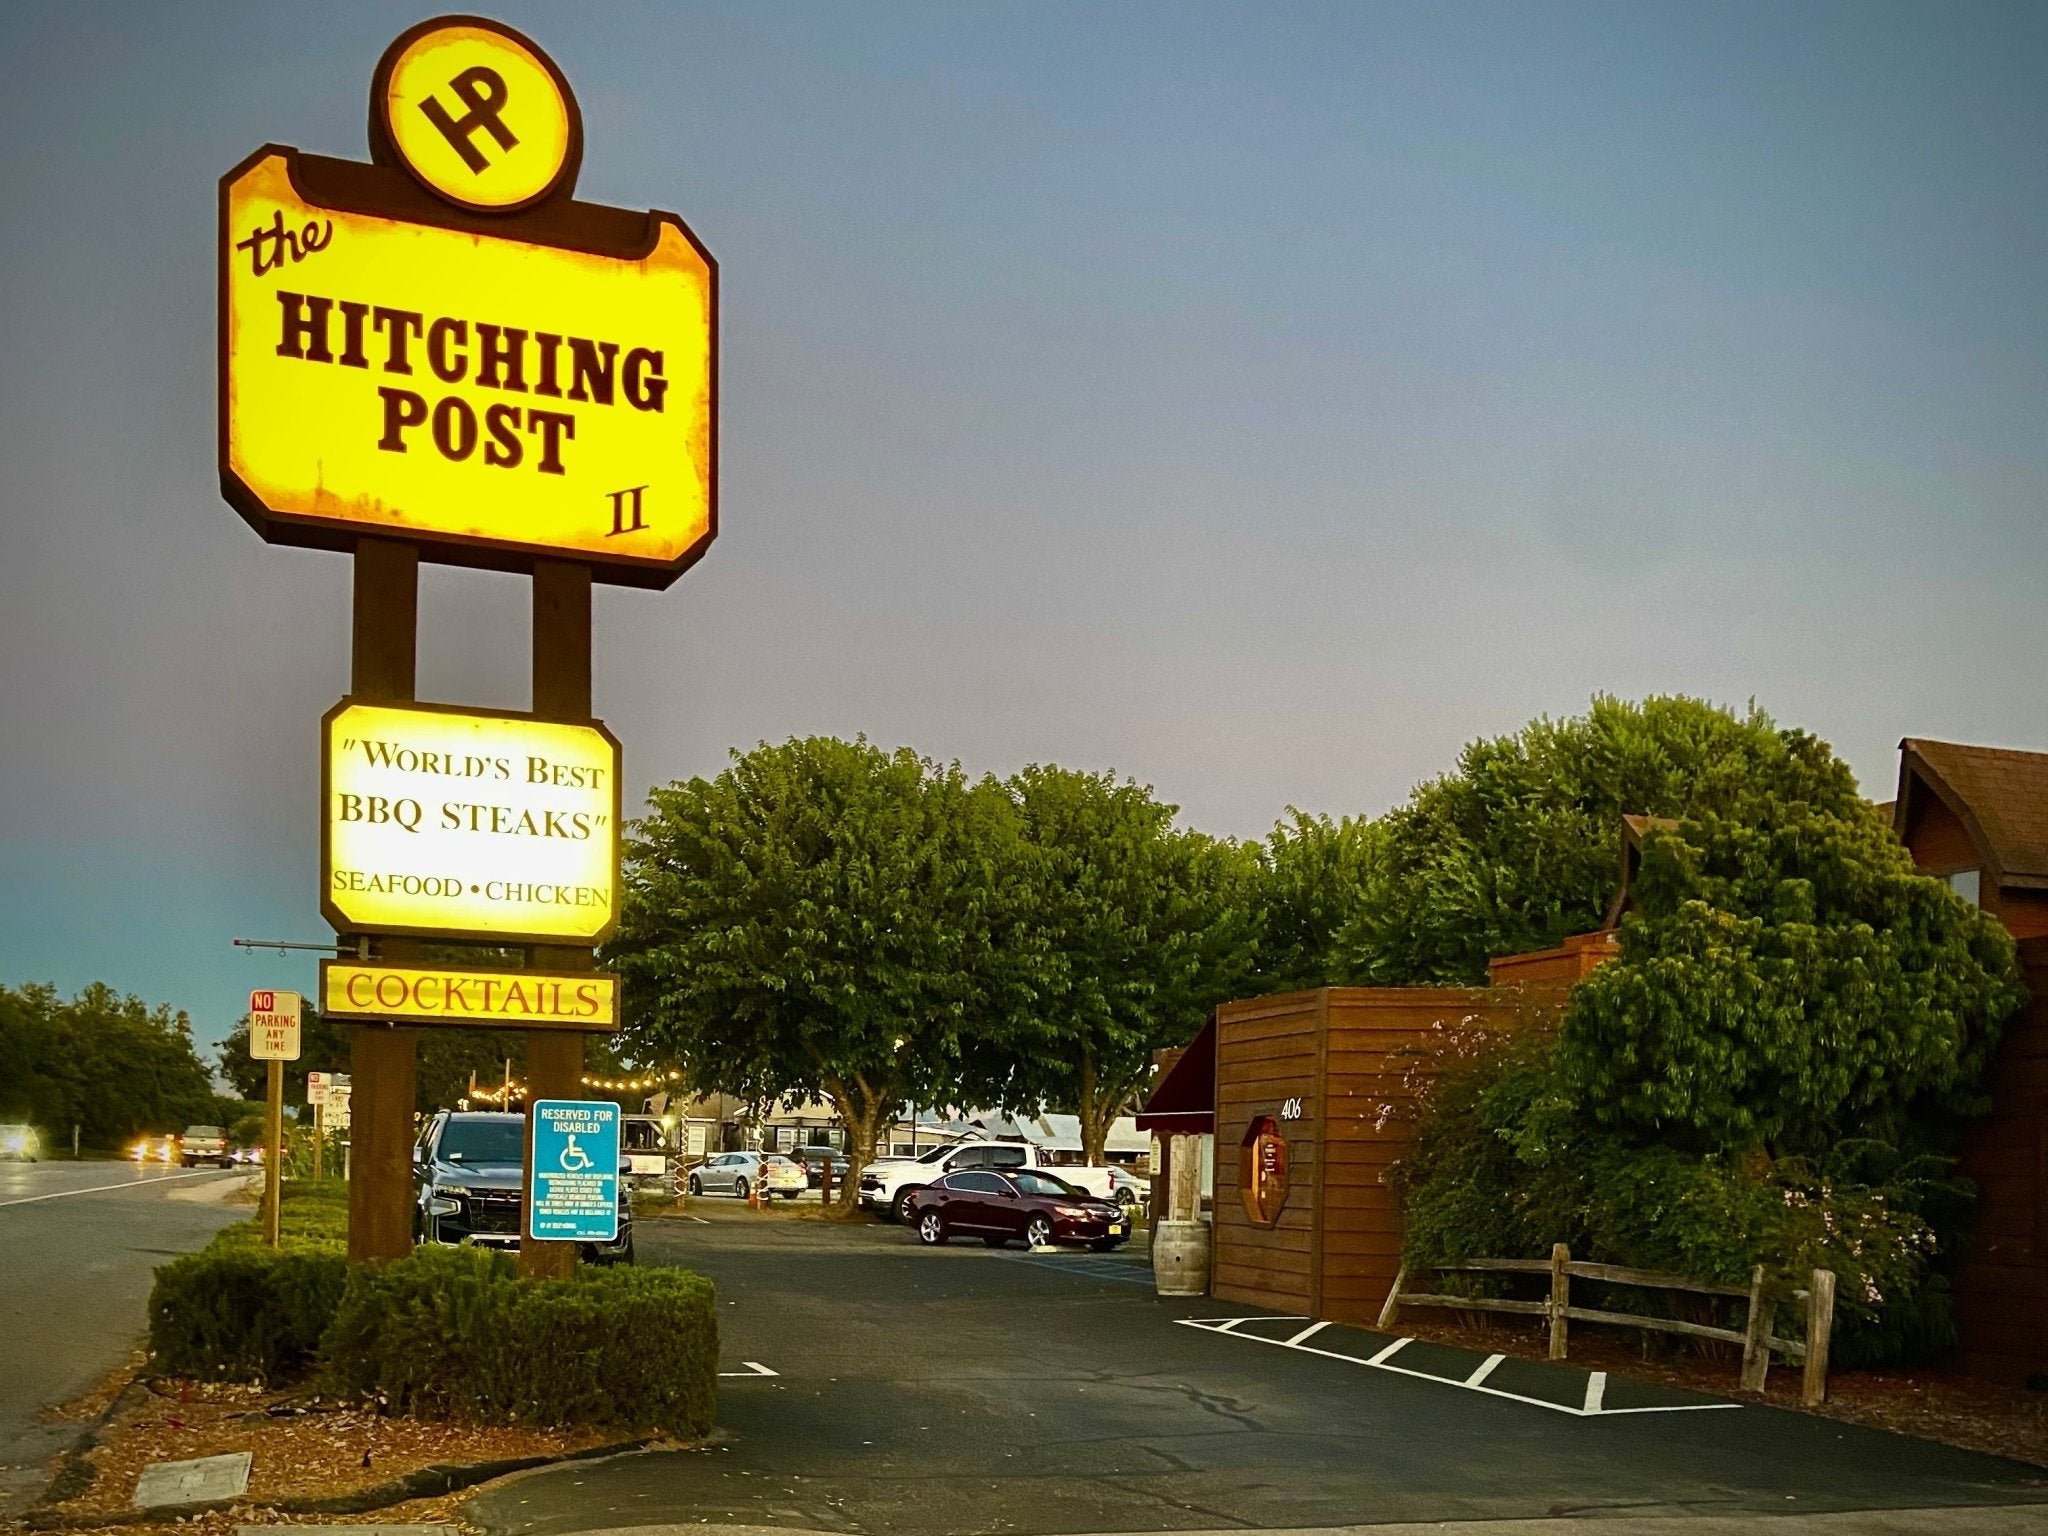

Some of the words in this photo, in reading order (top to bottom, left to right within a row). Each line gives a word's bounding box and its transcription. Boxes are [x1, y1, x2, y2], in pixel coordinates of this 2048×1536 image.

[236, 210, 333, 278] the
[276, 290, 668, 414] HITCHING
[377, 386, 575, 476] POST
[605, 485, 650, 538] II
[526, 756, 605, 790] BEST
[338, 793, 422, 833] BBQ
[441, 801, 607, 841] STEAKS"
[333, 870, 463, 898] SEAFOOD
[485, 881, 609, 908] CHICKEN
[254, 993, 272, 1009] NO
[346, 973, 600, 1017] COCKTAILS
[255, 1014, 296, 1028] PARKING
[266, 1029, 285, 1039] ANY
[265, 1041, 285, 1051] TIME
[541, 1108, 591, 1121] RESERVED
[594, 1110, 613, 1122] FOR
[1281, 1098, 1302, 1120] 406
[553, 1121, 600, 1134] DISABLED
